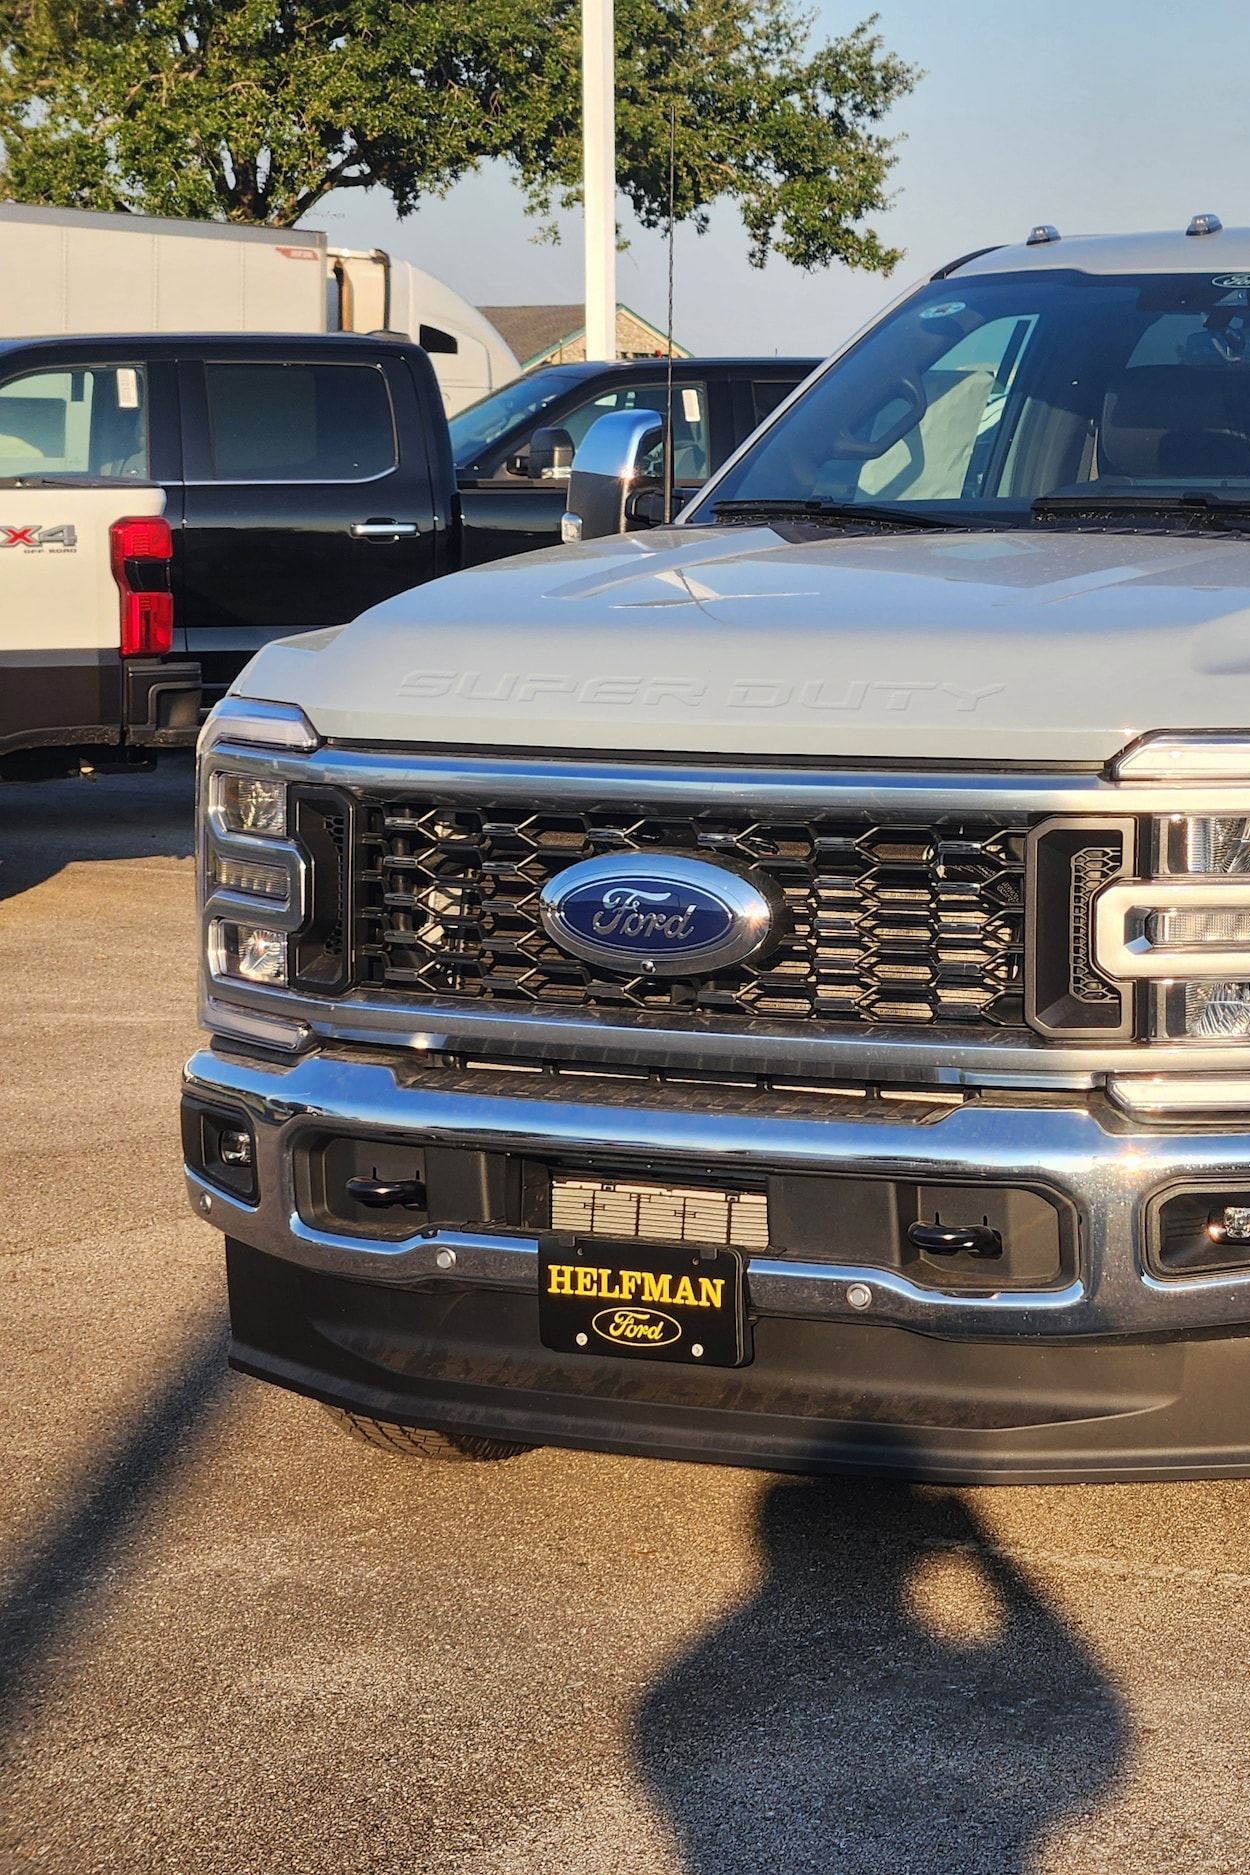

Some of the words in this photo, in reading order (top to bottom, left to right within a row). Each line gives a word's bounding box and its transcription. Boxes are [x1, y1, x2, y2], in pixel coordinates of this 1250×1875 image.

[397, 670, 708, 707] SUPER
[725, 680, 1005, 712] DUTY
[592, 887, 697, 940] Ford
[547, 1264, 726, 1309] HELFMAN
[608, 1311, 665, 1341] Ford
